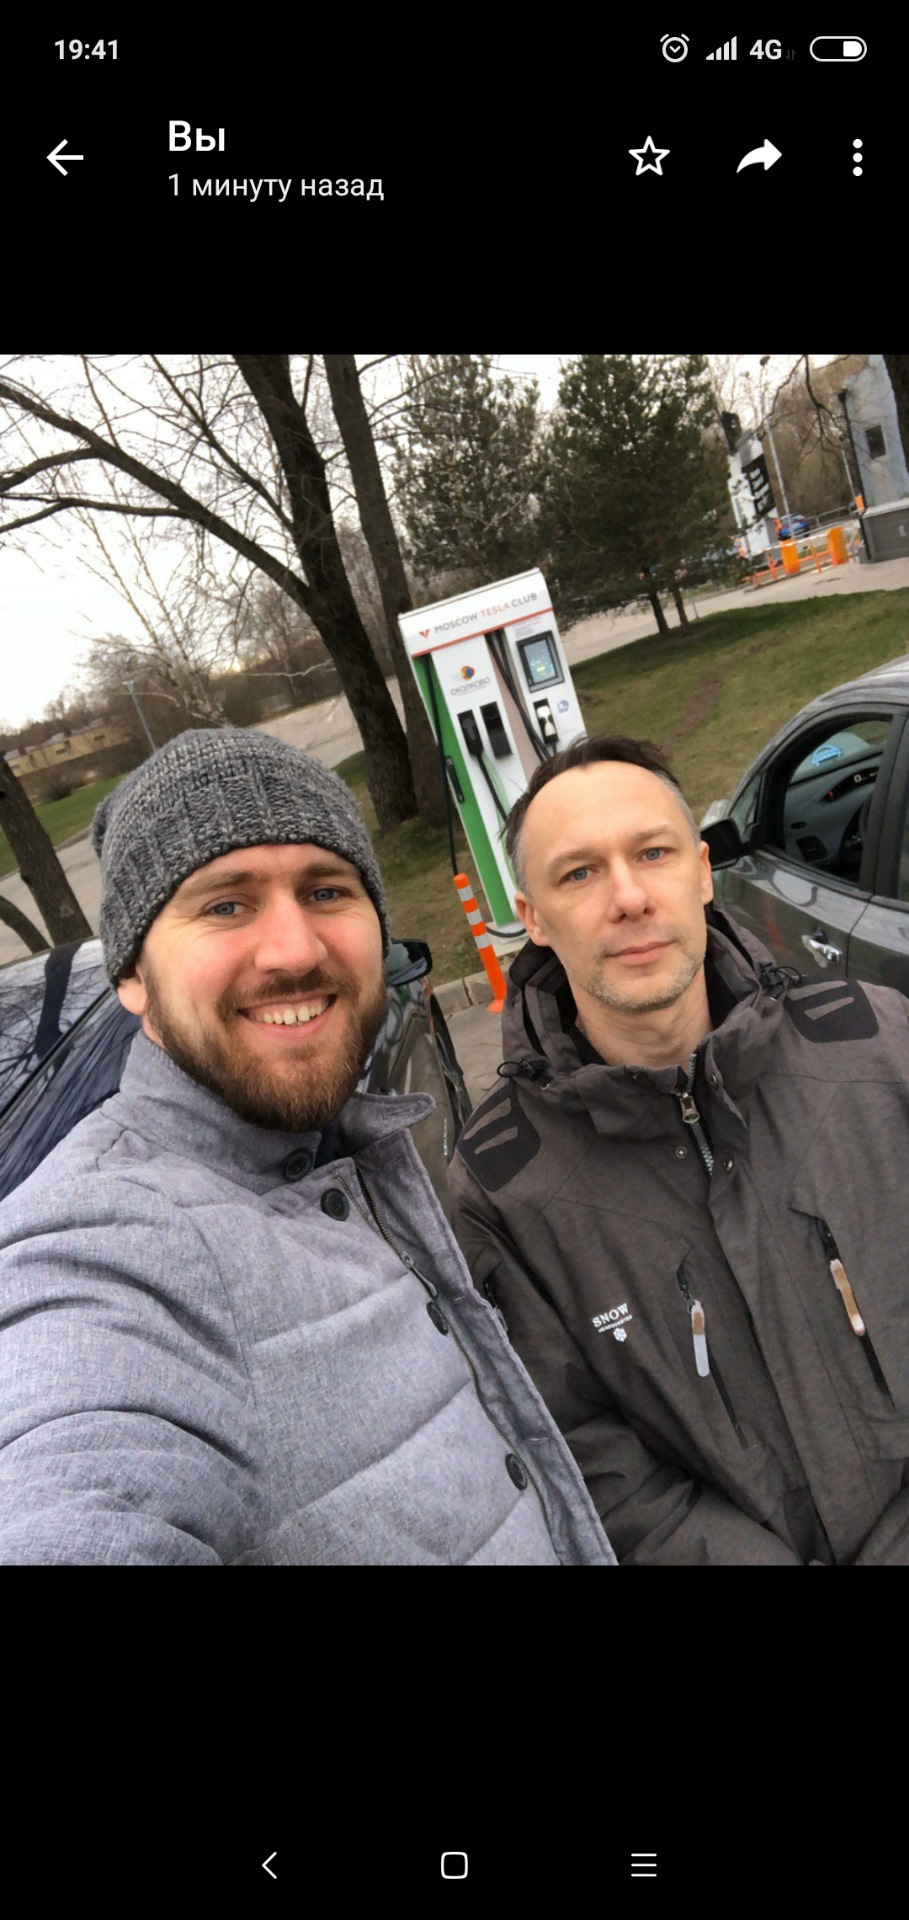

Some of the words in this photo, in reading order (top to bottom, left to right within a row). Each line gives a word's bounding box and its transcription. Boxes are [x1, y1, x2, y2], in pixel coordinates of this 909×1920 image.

[434, 613, 478, 633] MOSCOW
[480, 602, 510, 618] TESLA
[511, 592, 538, 608] CLUB
[592, 1303, 629, 1327] SNOW
